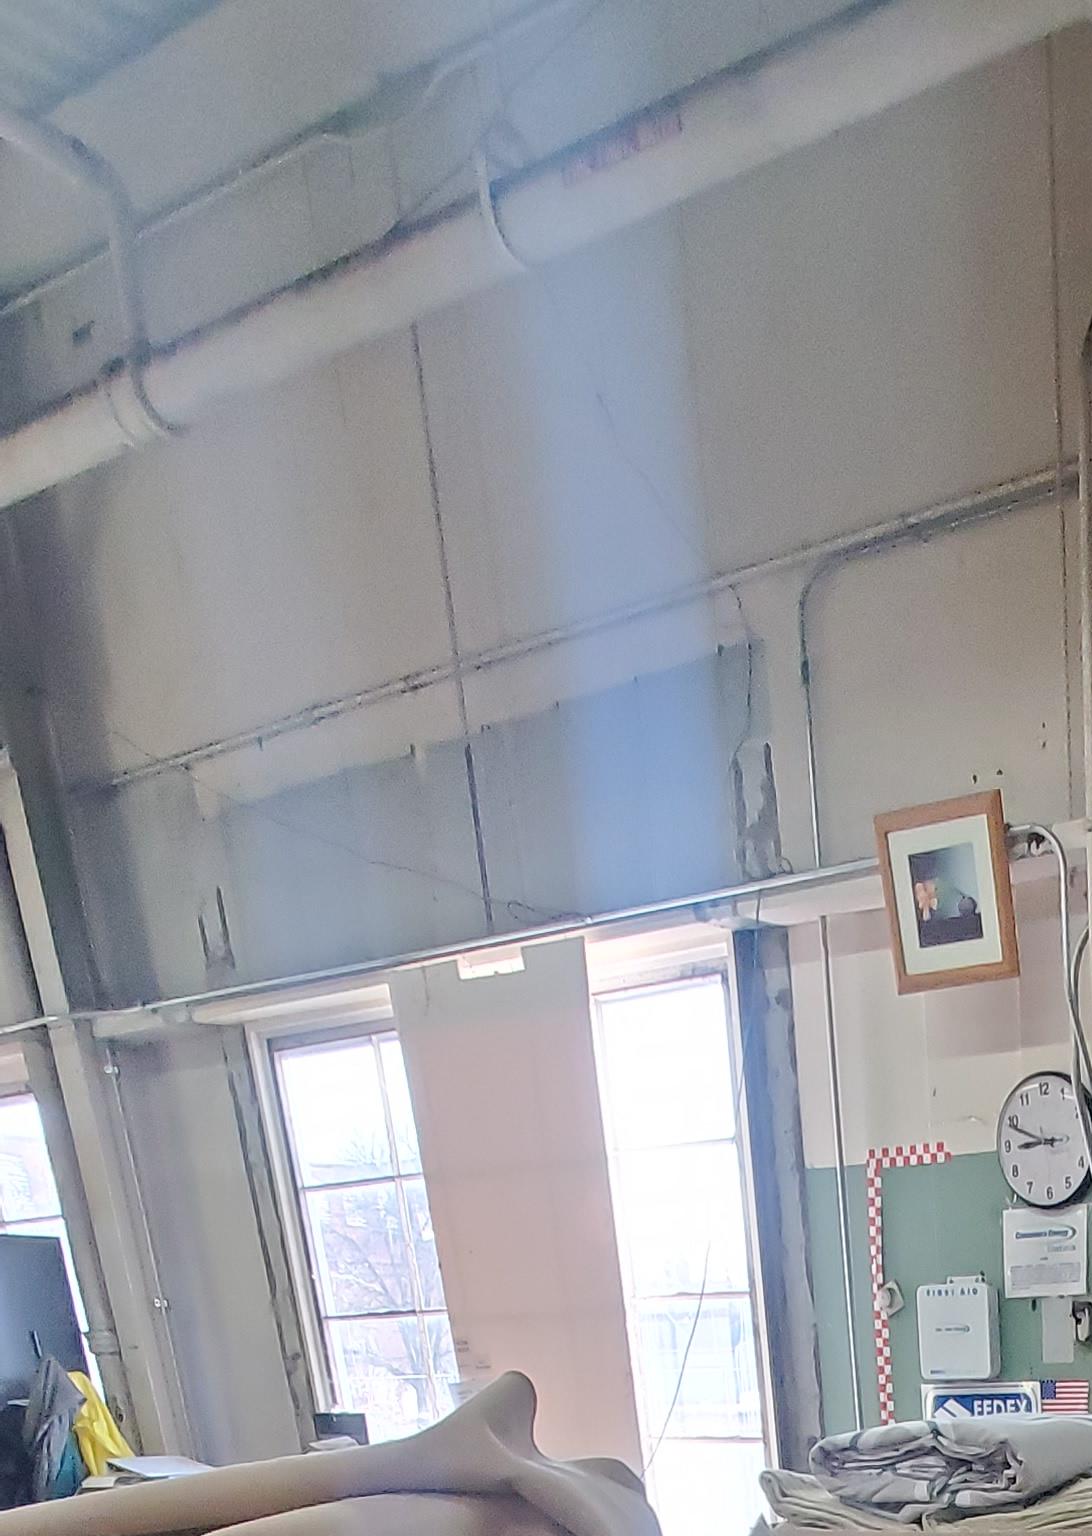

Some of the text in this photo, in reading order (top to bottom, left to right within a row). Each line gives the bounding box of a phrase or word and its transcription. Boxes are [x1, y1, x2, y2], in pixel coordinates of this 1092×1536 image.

[1039, 1082, 1049, 1096] 12
[1020, 1093, 1029, 1106] 11
[1005, 1140, 1011, 1153] 9
[1078, 1156, 1084, 1168] 4
[1012, 1164, 1019, 1178] 8
[1027, 1181, 1033, 1194] 7
[1065, 1176, 1072, 1189] 5
[1047, 1186, 1053, 1200] 6
